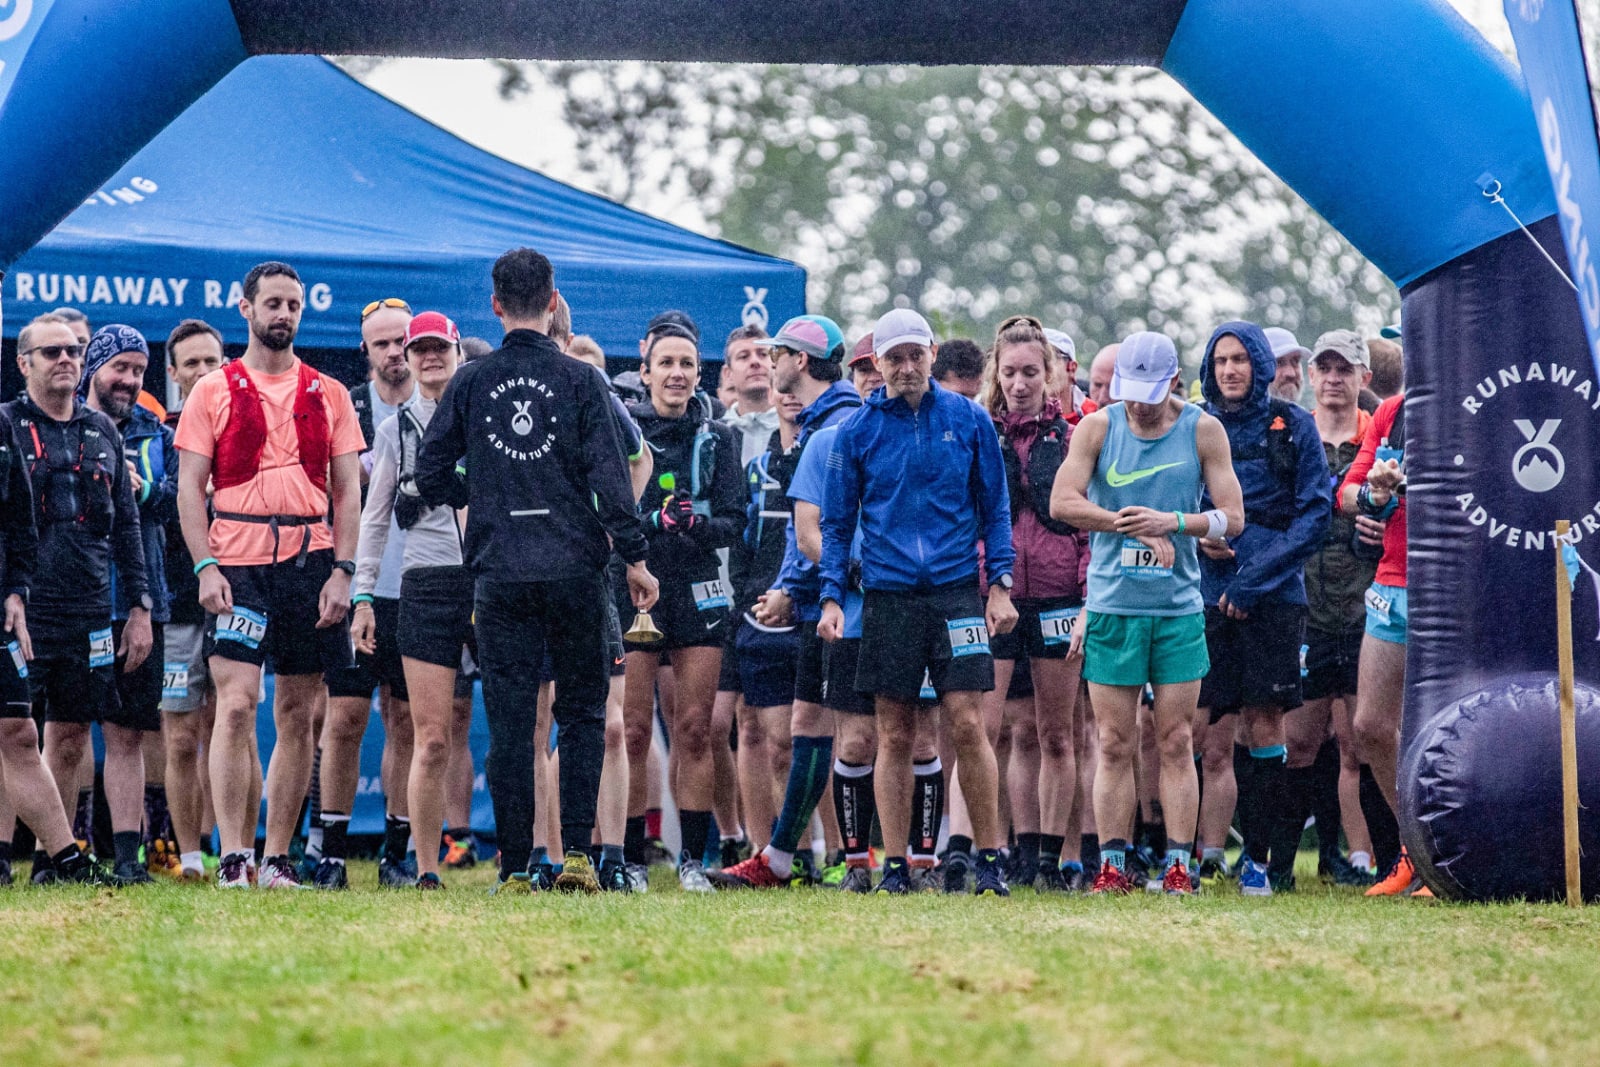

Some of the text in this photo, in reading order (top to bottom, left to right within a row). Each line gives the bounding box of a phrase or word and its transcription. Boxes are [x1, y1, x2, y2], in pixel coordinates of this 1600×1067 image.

[84, 176, 158, 206] ING
[16, 272, 333, 312] RUNAWAY RAG
[490, 377, 554, 400] RUNAWAY
[228, 615, 254, 637] 121
[965, 627, 982, 644] 31
